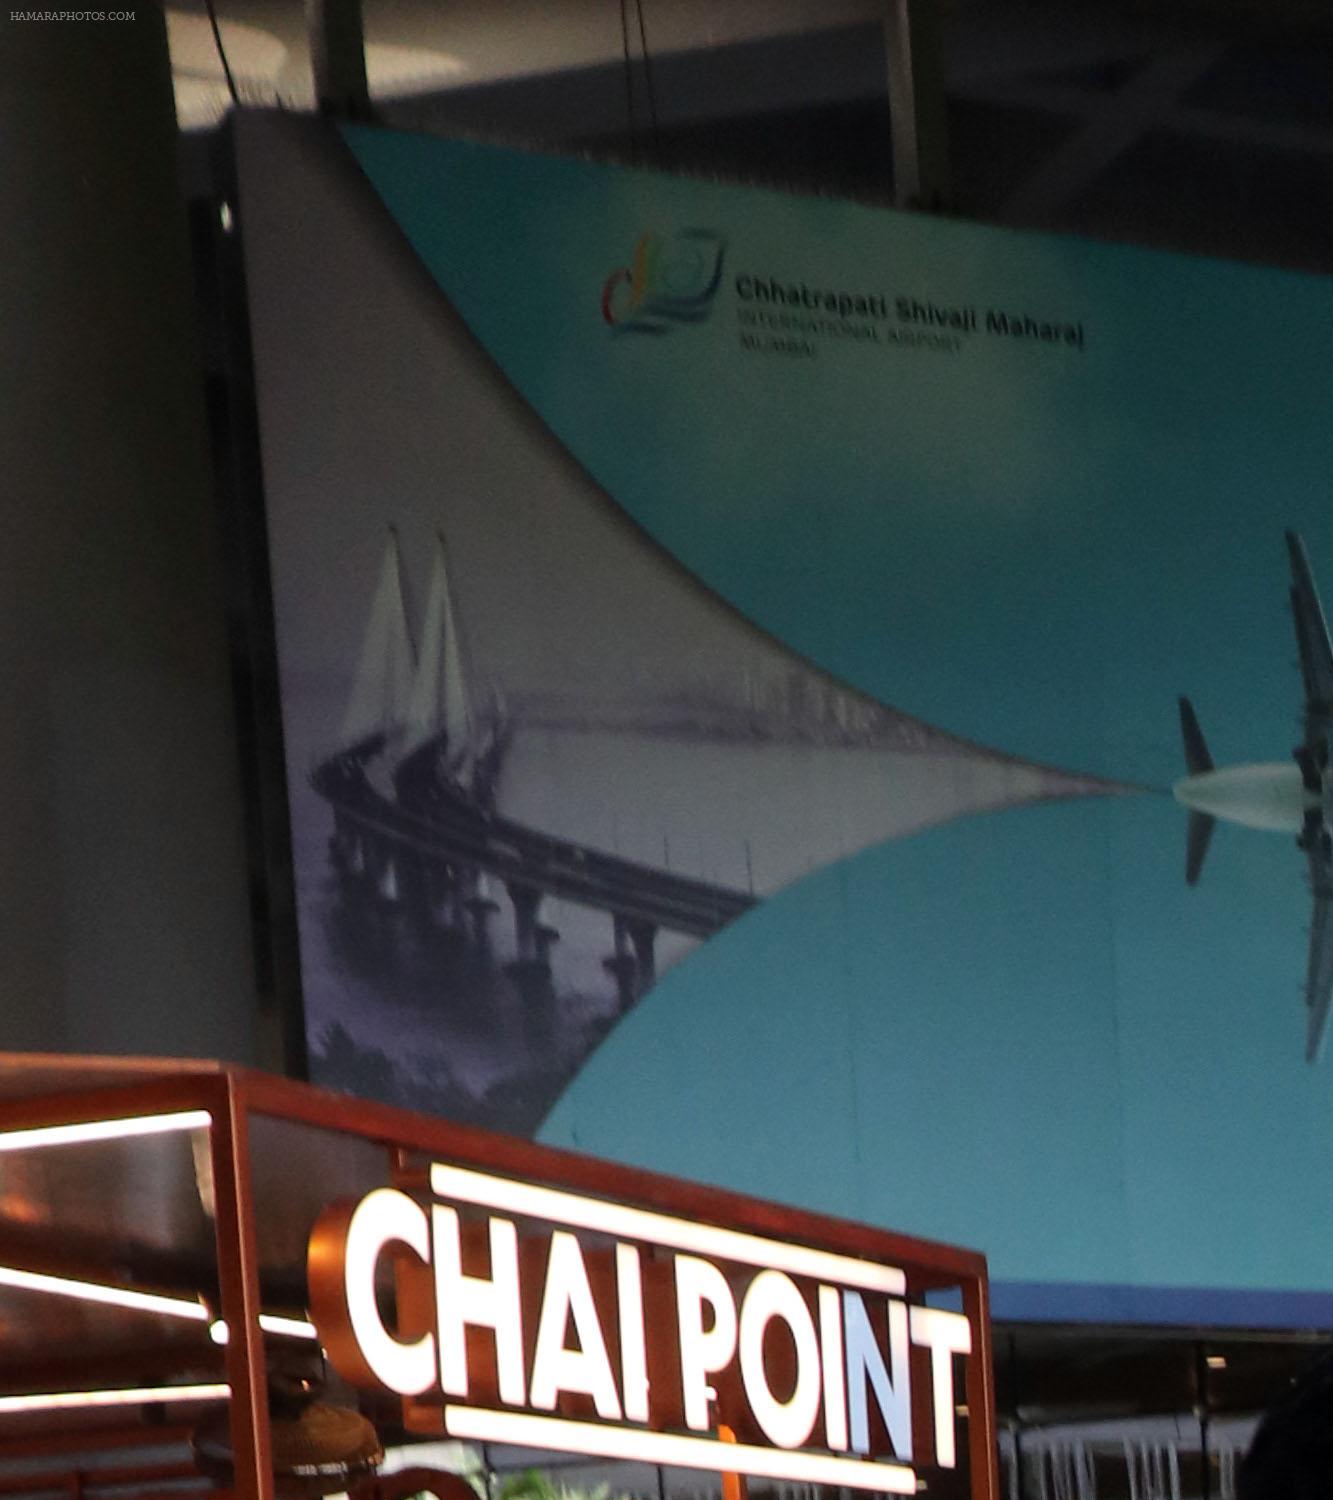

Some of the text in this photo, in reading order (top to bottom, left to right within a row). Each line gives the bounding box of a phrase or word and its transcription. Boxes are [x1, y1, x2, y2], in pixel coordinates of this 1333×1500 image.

[735, 274, 1085, 349] Chhatrapati Shivaji Maharaj
[343, 1186, 972, 1471] CHAI POINT
